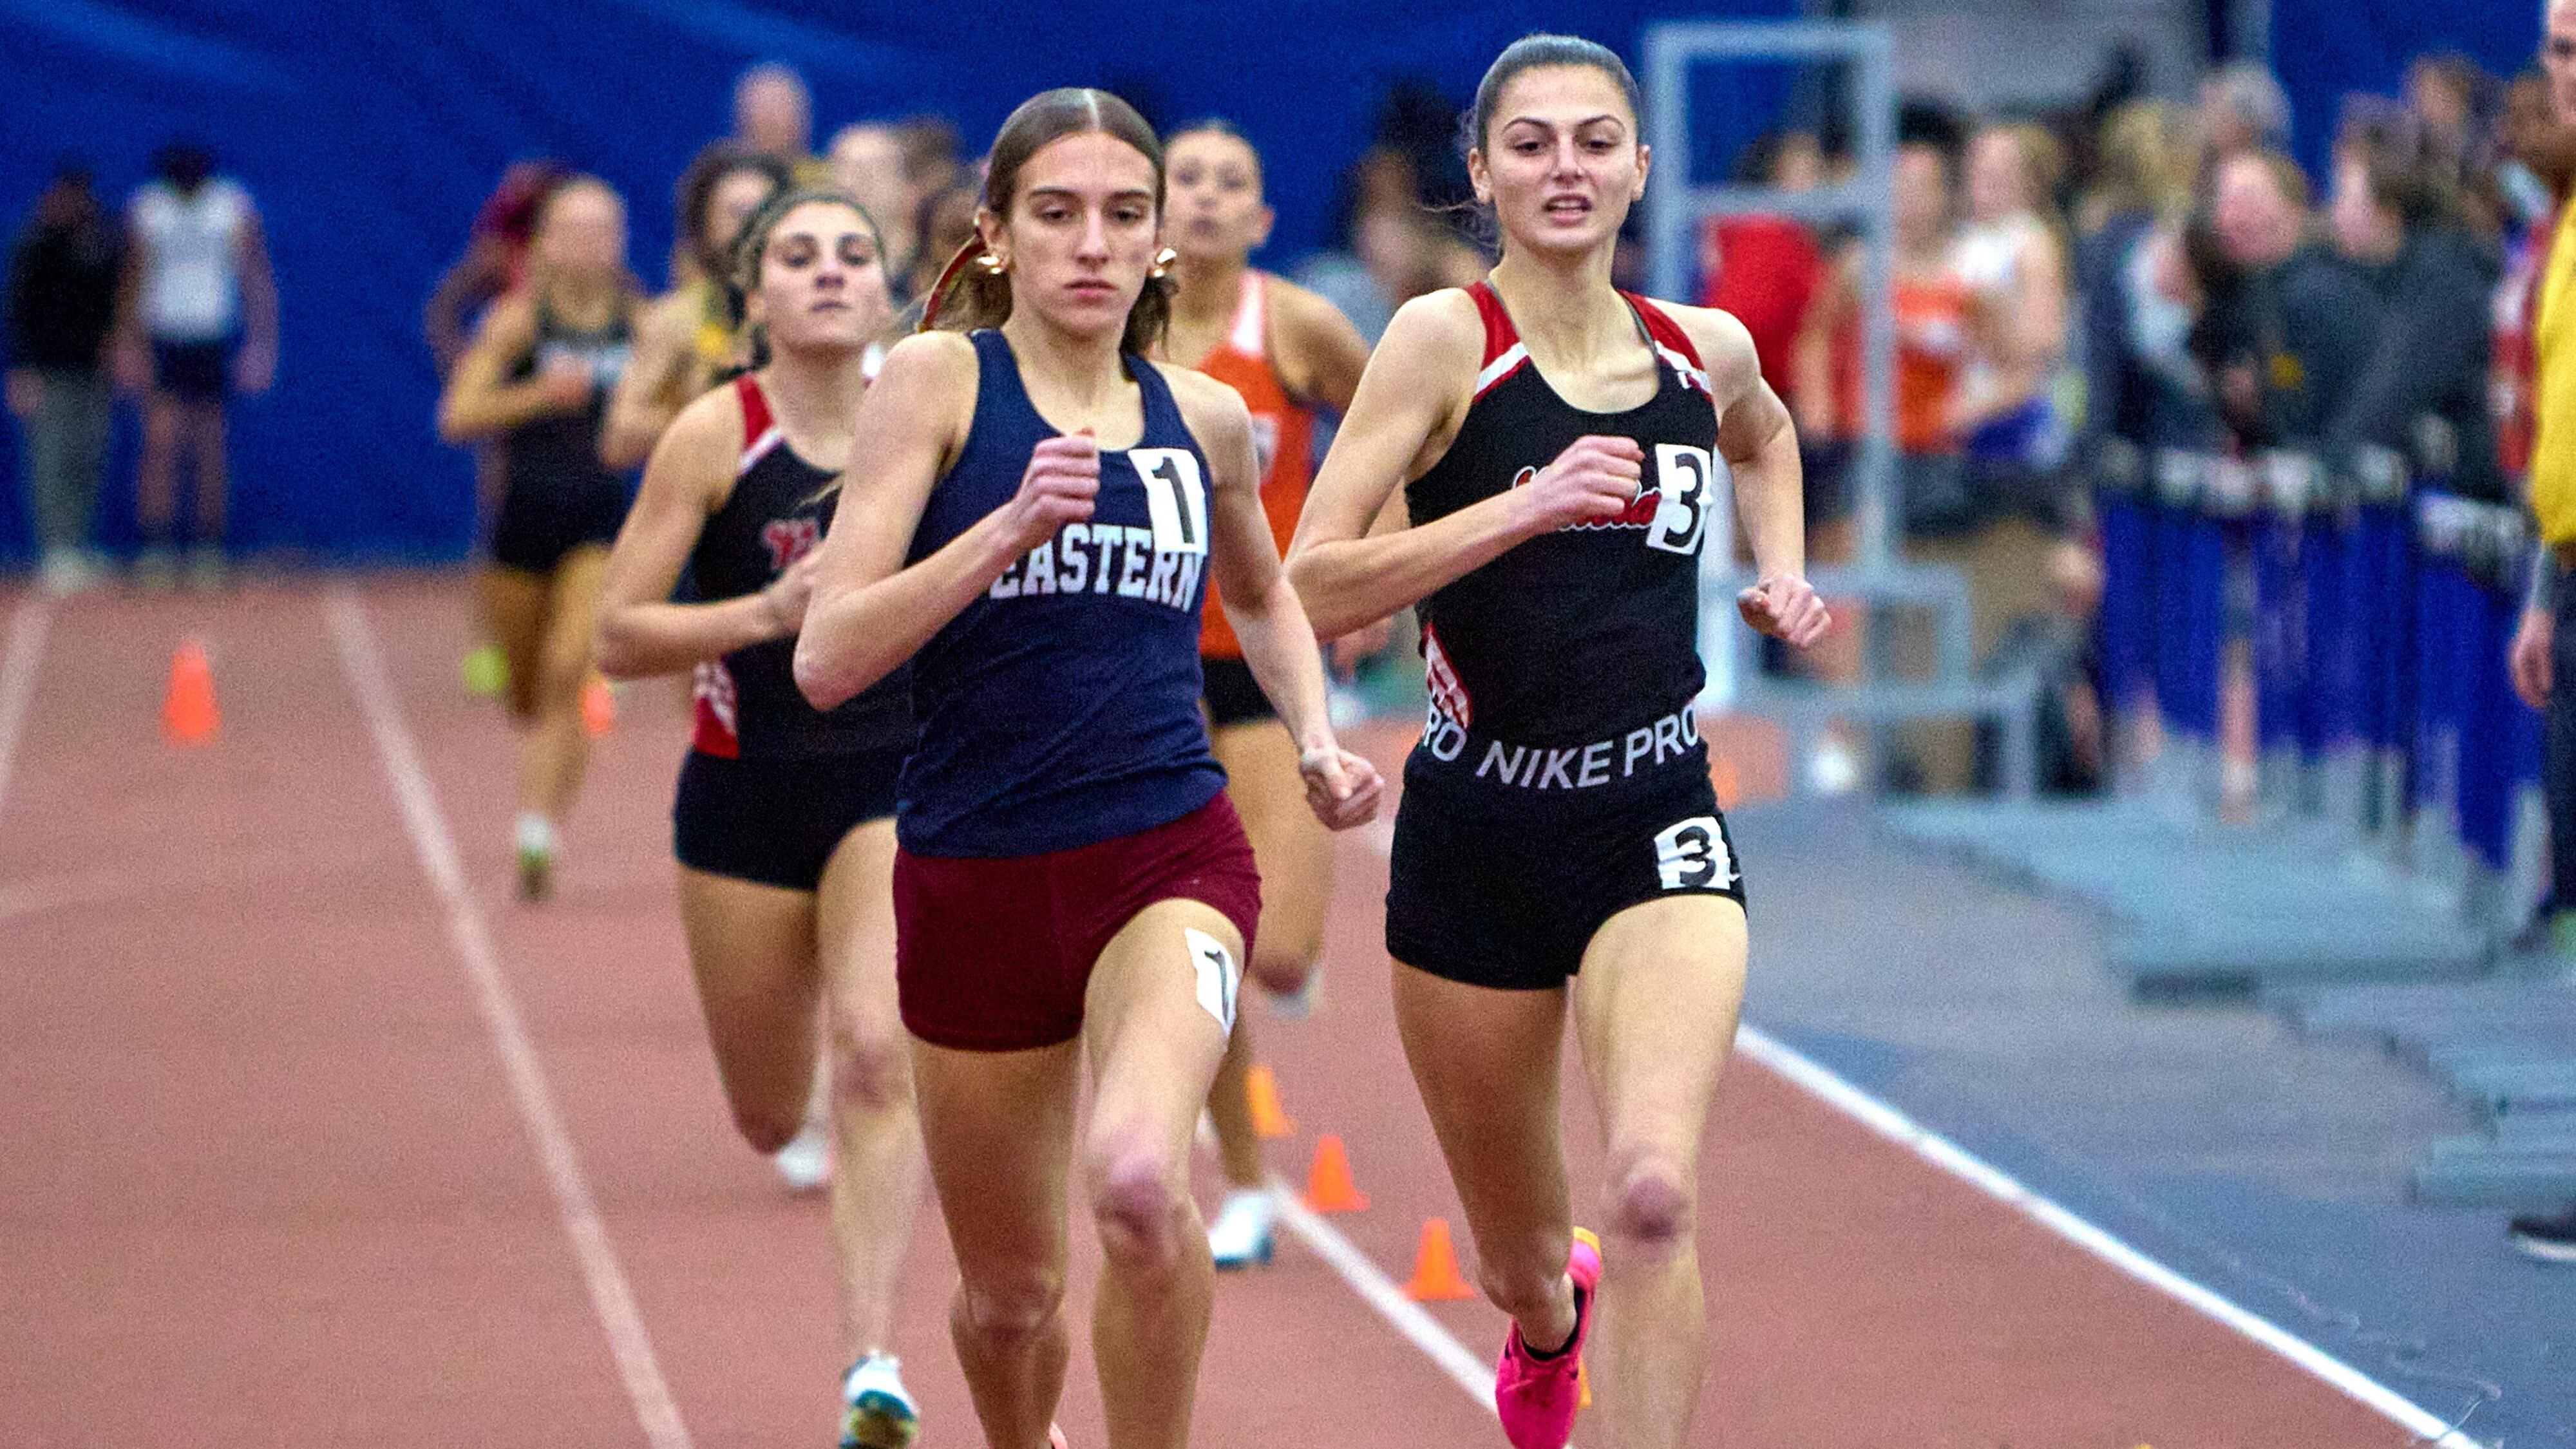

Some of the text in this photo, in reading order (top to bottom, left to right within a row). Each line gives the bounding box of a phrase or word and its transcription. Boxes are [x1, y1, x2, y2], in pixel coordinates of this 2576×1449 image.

[1151, 456, 1196, 544] 1
[1662, 452, 1703, 549] 3
[1476, 739, 1614, 790] NIKE
[1624, 703, 1699, 777] PRO
[1675, 825, 1717, 886] 3
[1204, 950, 1229, 1023] 1
